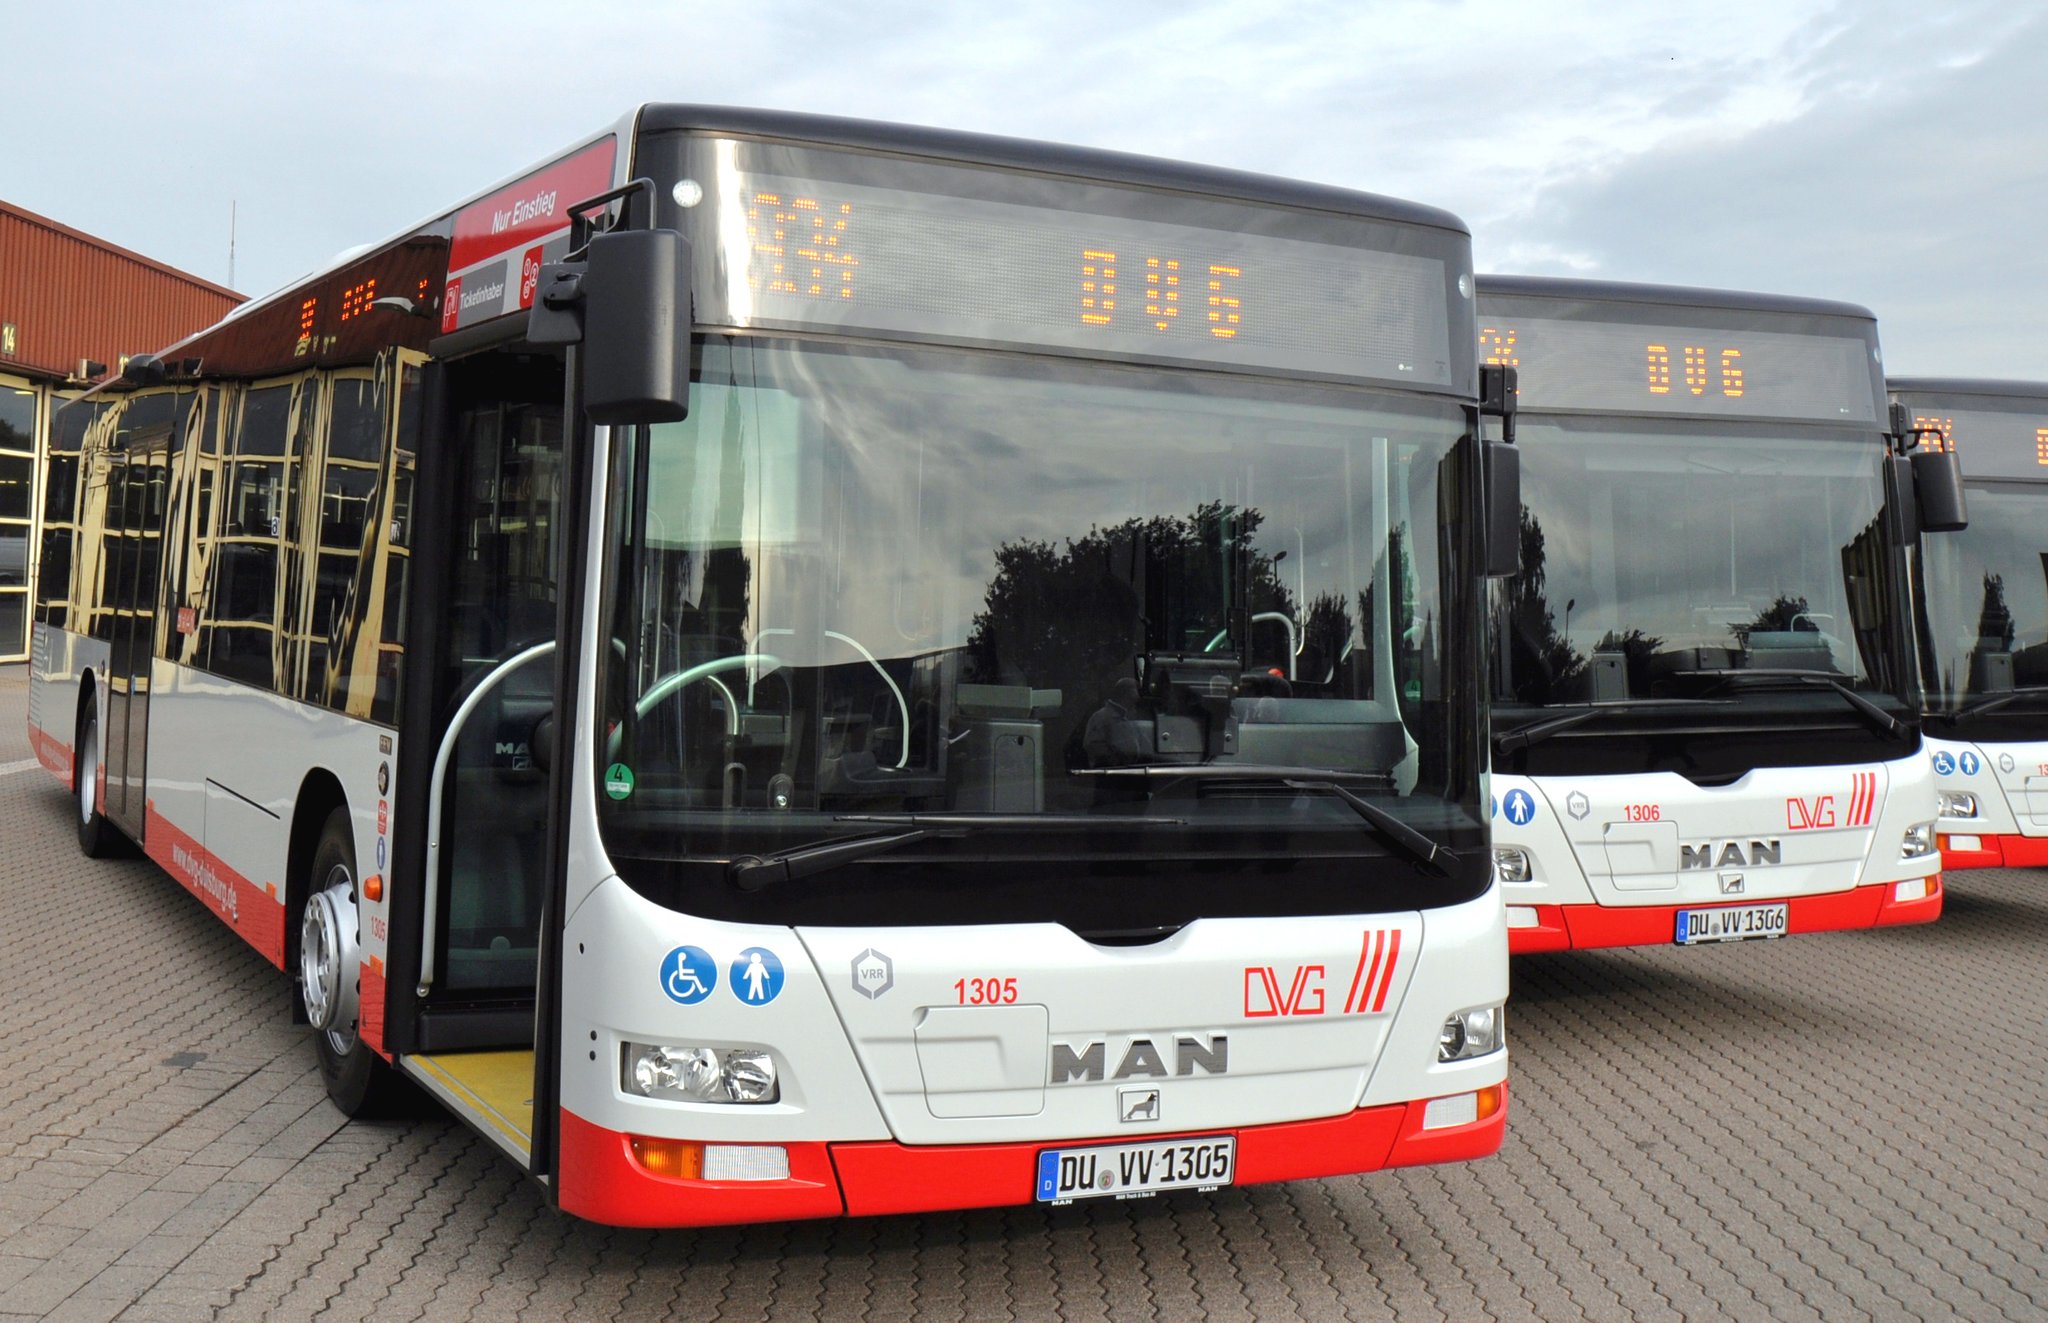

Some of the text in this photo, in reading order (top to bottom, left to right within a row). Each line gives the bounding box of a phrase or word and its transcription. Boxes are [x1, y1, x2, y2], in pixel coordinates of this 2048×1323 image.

[491, 190, 557, 235] Nur Einstieg
[460, 282, 504, 310] Ticketinhaber
[3, 326, 15, 352] 14
[496, 743, 529, 754] MA
[614, 764, 623, 782] 4
[1624, 804, 1660, 821] 1306
[1786, 796, 1836, 829] DVG
[1680, 838, 1781, 869] MAN
[371, 915, 385, 941] 1305
[1689, 913, 1709, 936] DU
[1722, 911, 1741, 933] VV
[1745, 908, 1784, 932] 1306
[861, 968, 884, 979] VRR
[954, 977, 1018, 1005] 1305
[1244, 965, 1326, 1018] DVG
[1050, 1032, 1228, 1083] MAN
[1044, 1144, 1229, 1191] D DU VV 1305
